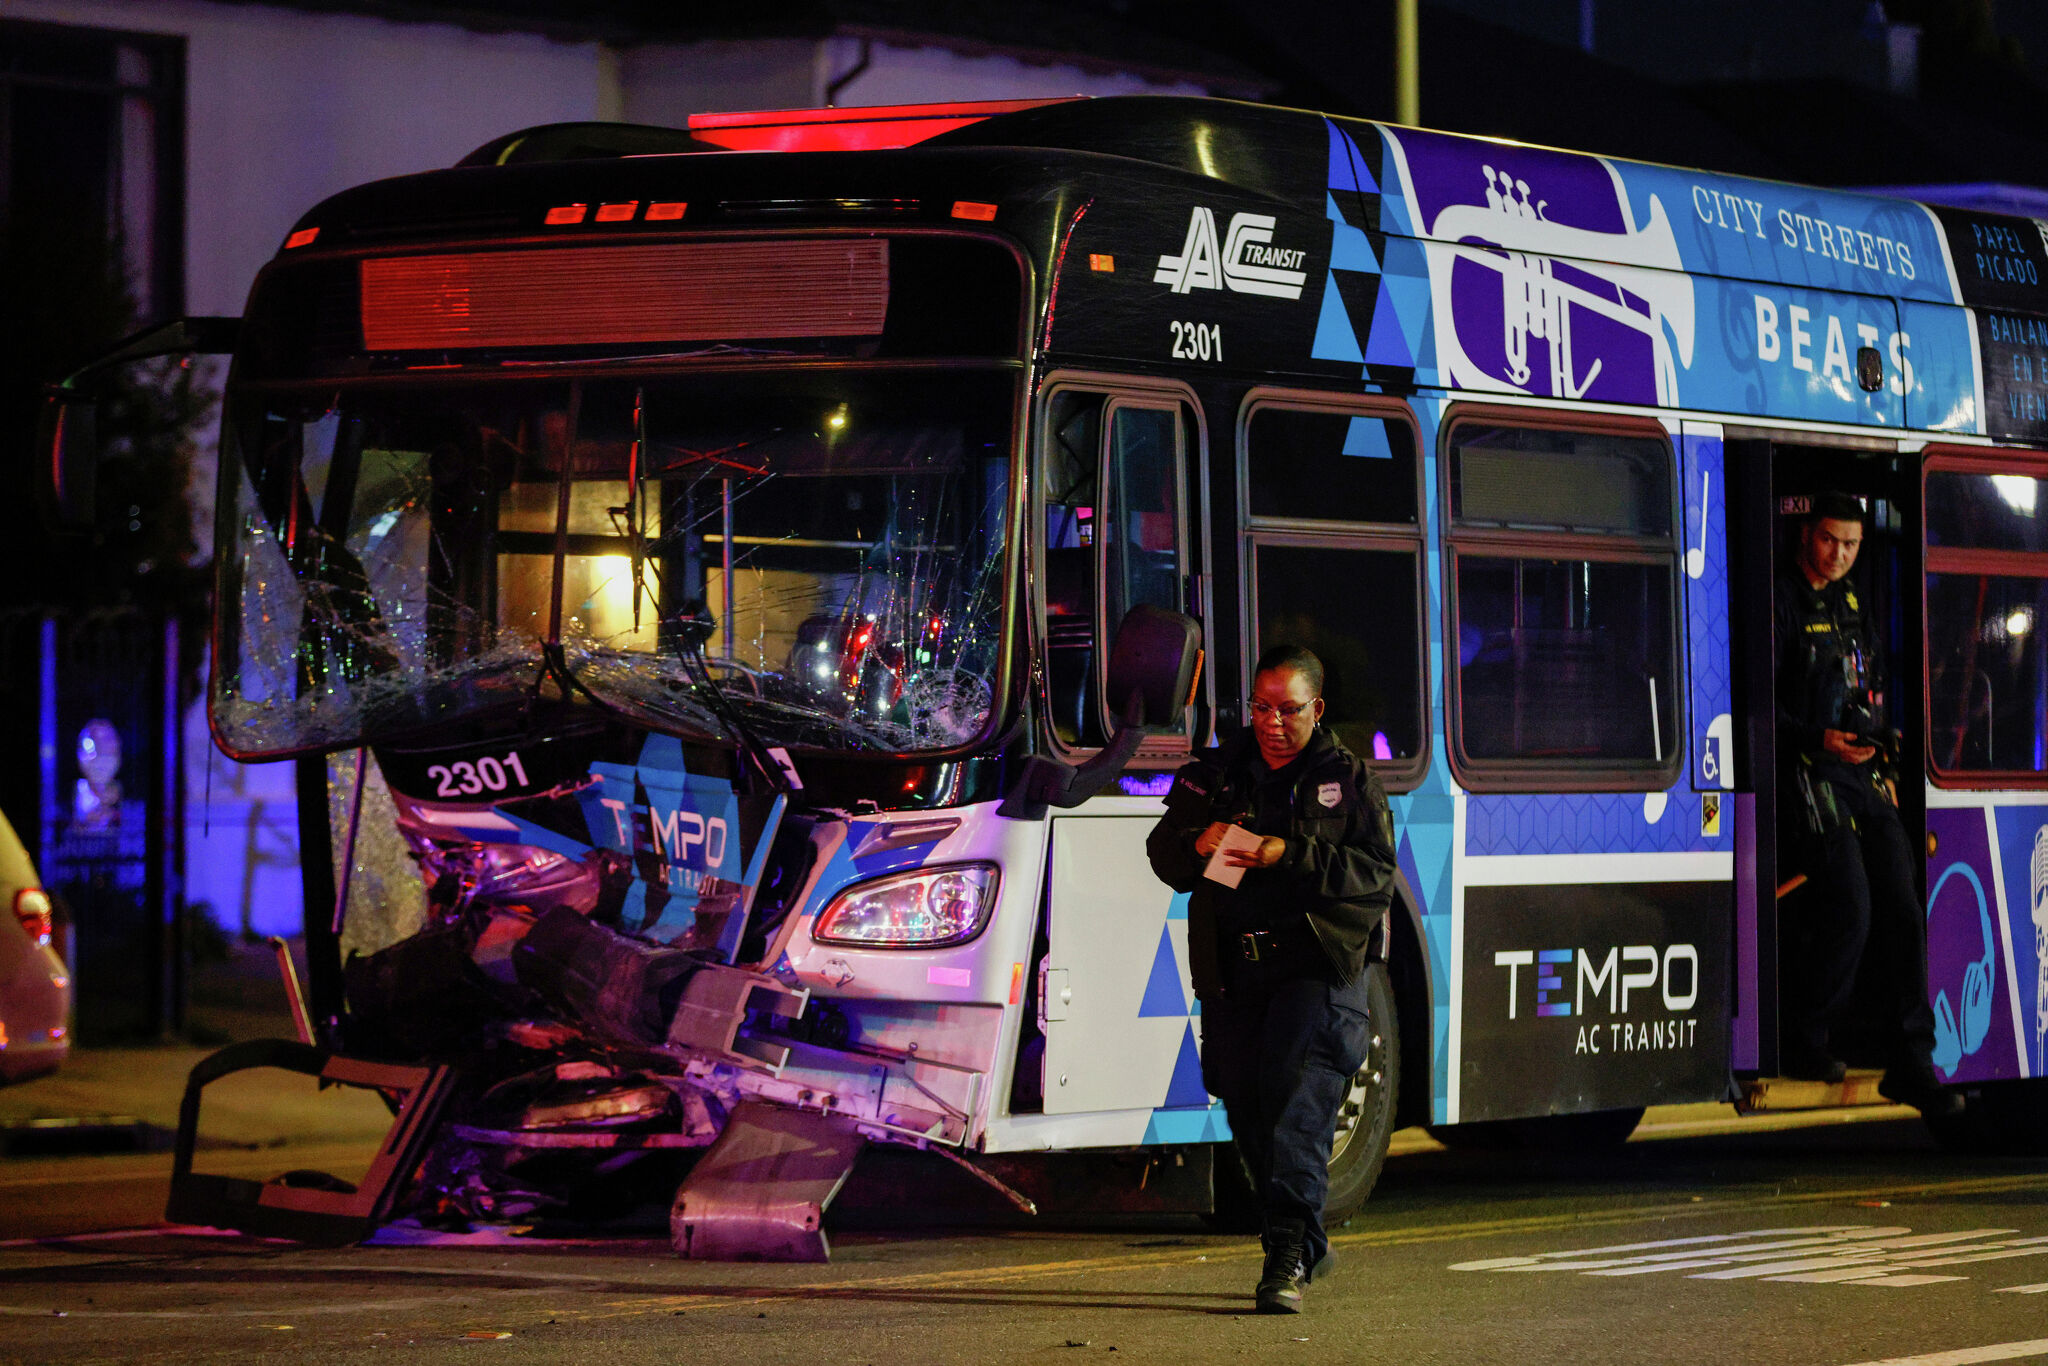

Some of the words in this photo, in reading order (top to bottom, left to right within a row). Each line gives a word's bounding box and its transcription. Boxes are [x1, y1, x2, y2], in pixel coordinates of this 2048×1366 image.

[1153, 206, 1307, 300] AC
[1692, 185, 1766, 239] CITY
[1777, 208, 1916, 281] STREETS
[1971, 223, 2024, 254] PAPEL
[1246, 244, 1307, 269] TRANSIT
[1975, 253, 2038, 285] PICADO
[1170, 320, 1223, 362] 2301
[2013, 354, 2033, 383] EN
[427, 751, 529, 798] 2301
[600, 798, 727, 868] TEMPO
[677, 867, 720, 896] TRASIT
[1495, 944, 1698, 1020] TEMPO
[1575, 1025, 1600, 1055] AC
[1611, 1019, 1697, 1052] TRANSIT
[1448, 1225, 2048, 1294] ONL
